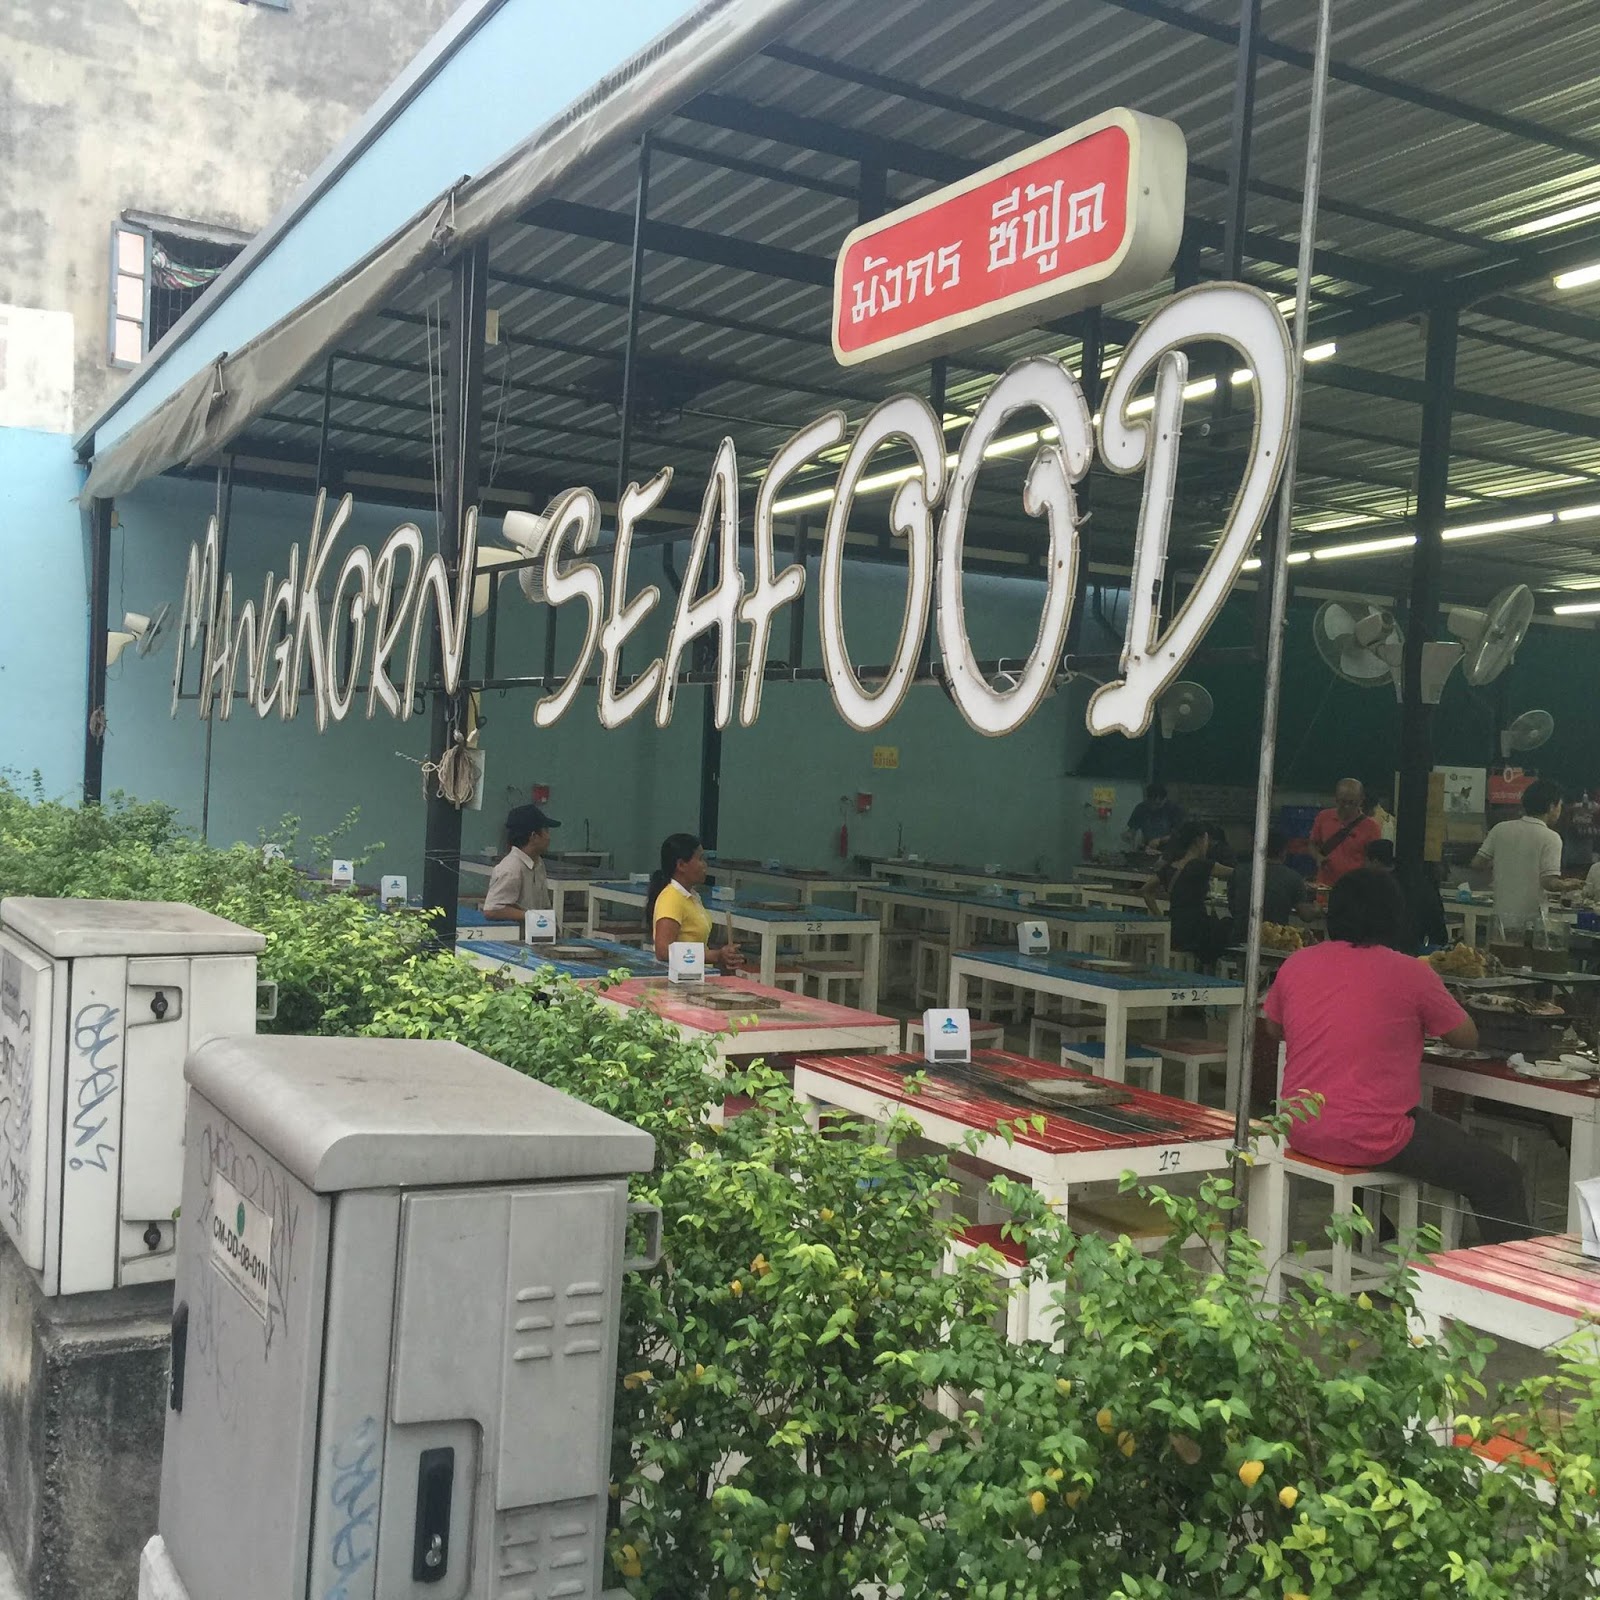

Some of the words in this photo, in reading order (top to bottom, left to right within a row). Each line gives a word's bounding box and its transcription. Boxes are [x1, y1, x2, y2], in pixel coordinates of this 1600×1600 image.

[851, 239, 964, 324] มังกร
[986, 179, 1108, 274] ซีฟู้ด
[533, 279, 1295, 739] SEAFOOD
[1158, 1150, 1181, 1172] 17
